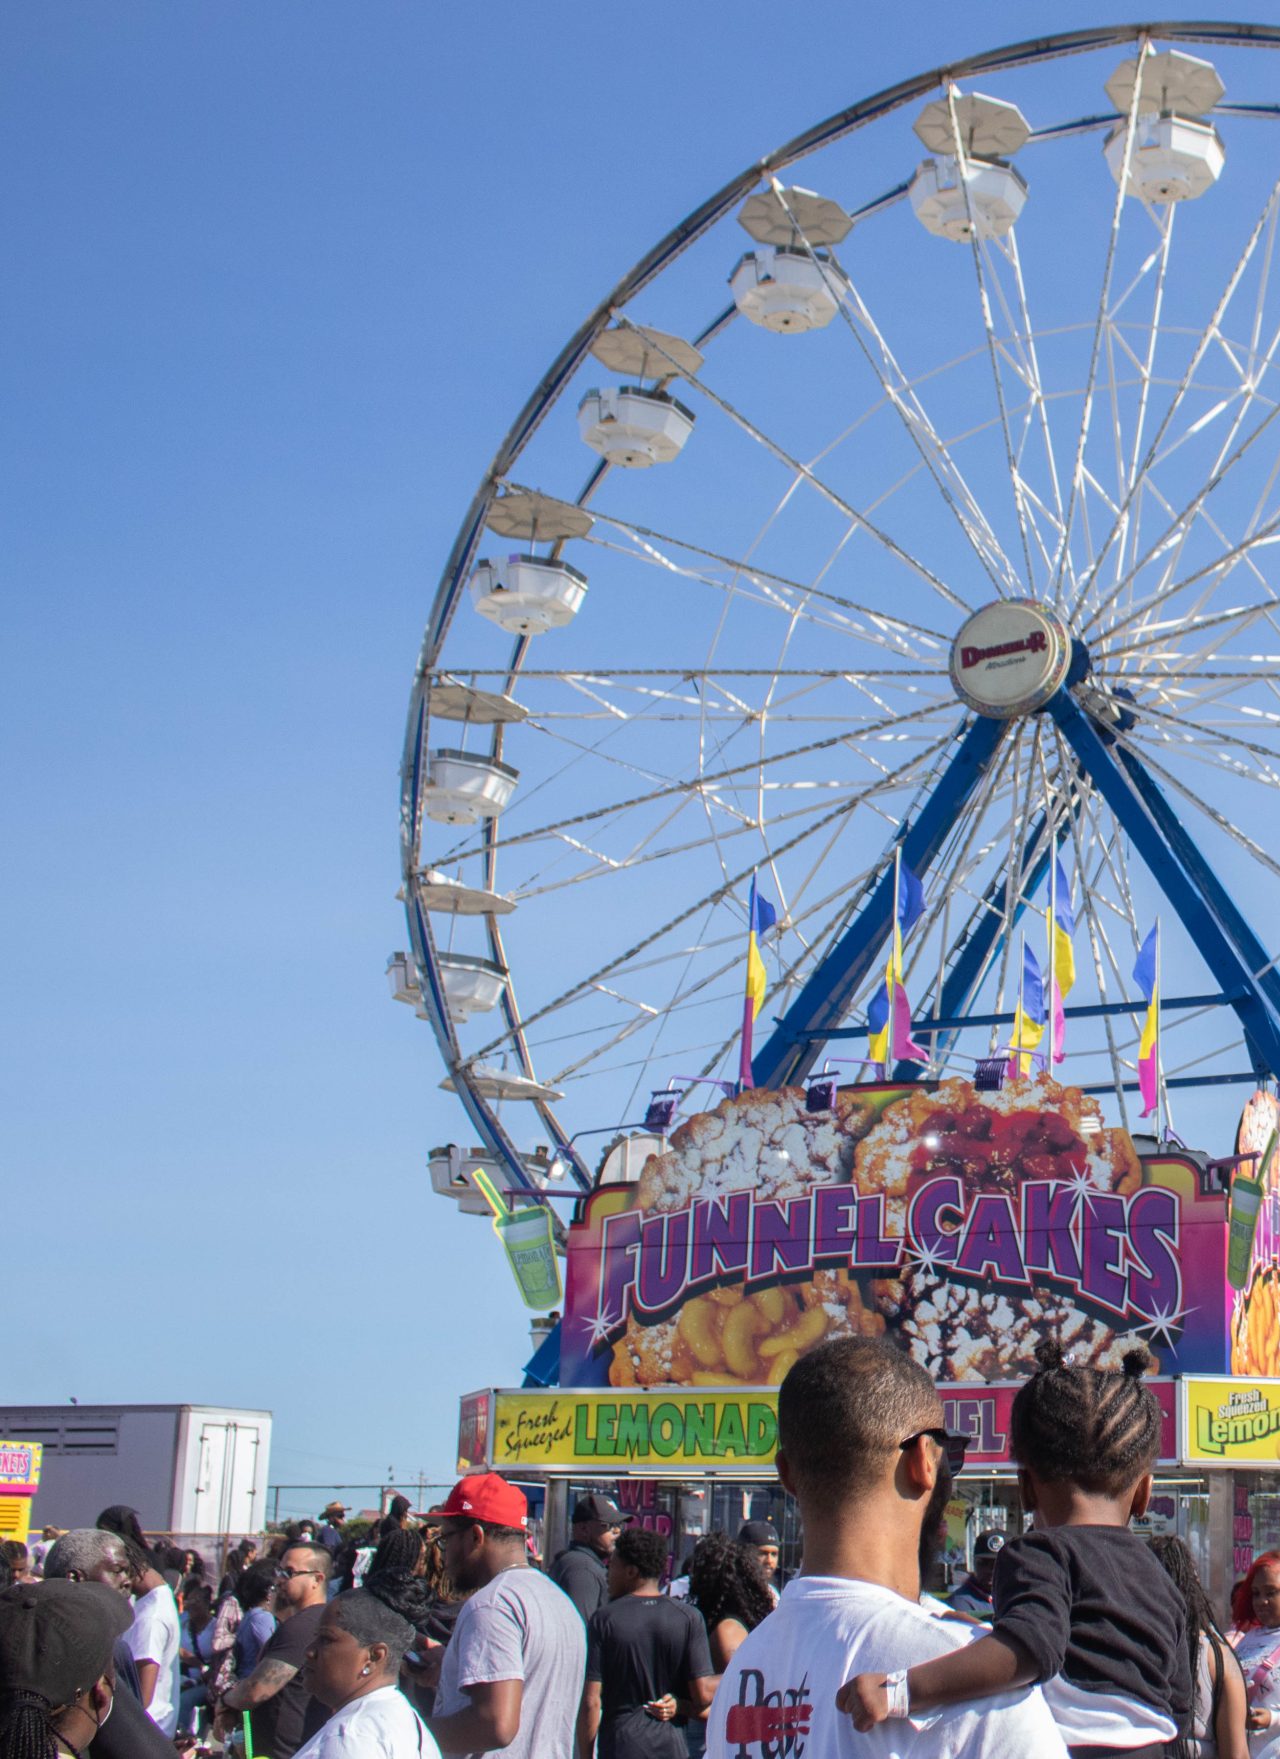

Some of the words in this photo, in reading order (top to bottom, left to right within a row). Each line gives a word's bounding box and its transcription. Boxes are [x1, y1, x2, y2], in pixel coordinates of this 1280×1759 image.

[597, 1184, 905, 1340] FUNNEL
[907, 1176, 1184, 1328] CAKES
[1218, 1398, 1268, 1419] Squeezed
[1229, 1389, 1262, 1405] Fresh
[505, 1415, 572, 1460] Squeezed
[517, 1401, 559, 1436] Fresh
[574, 1402, 783, 1462] LEMONAD
